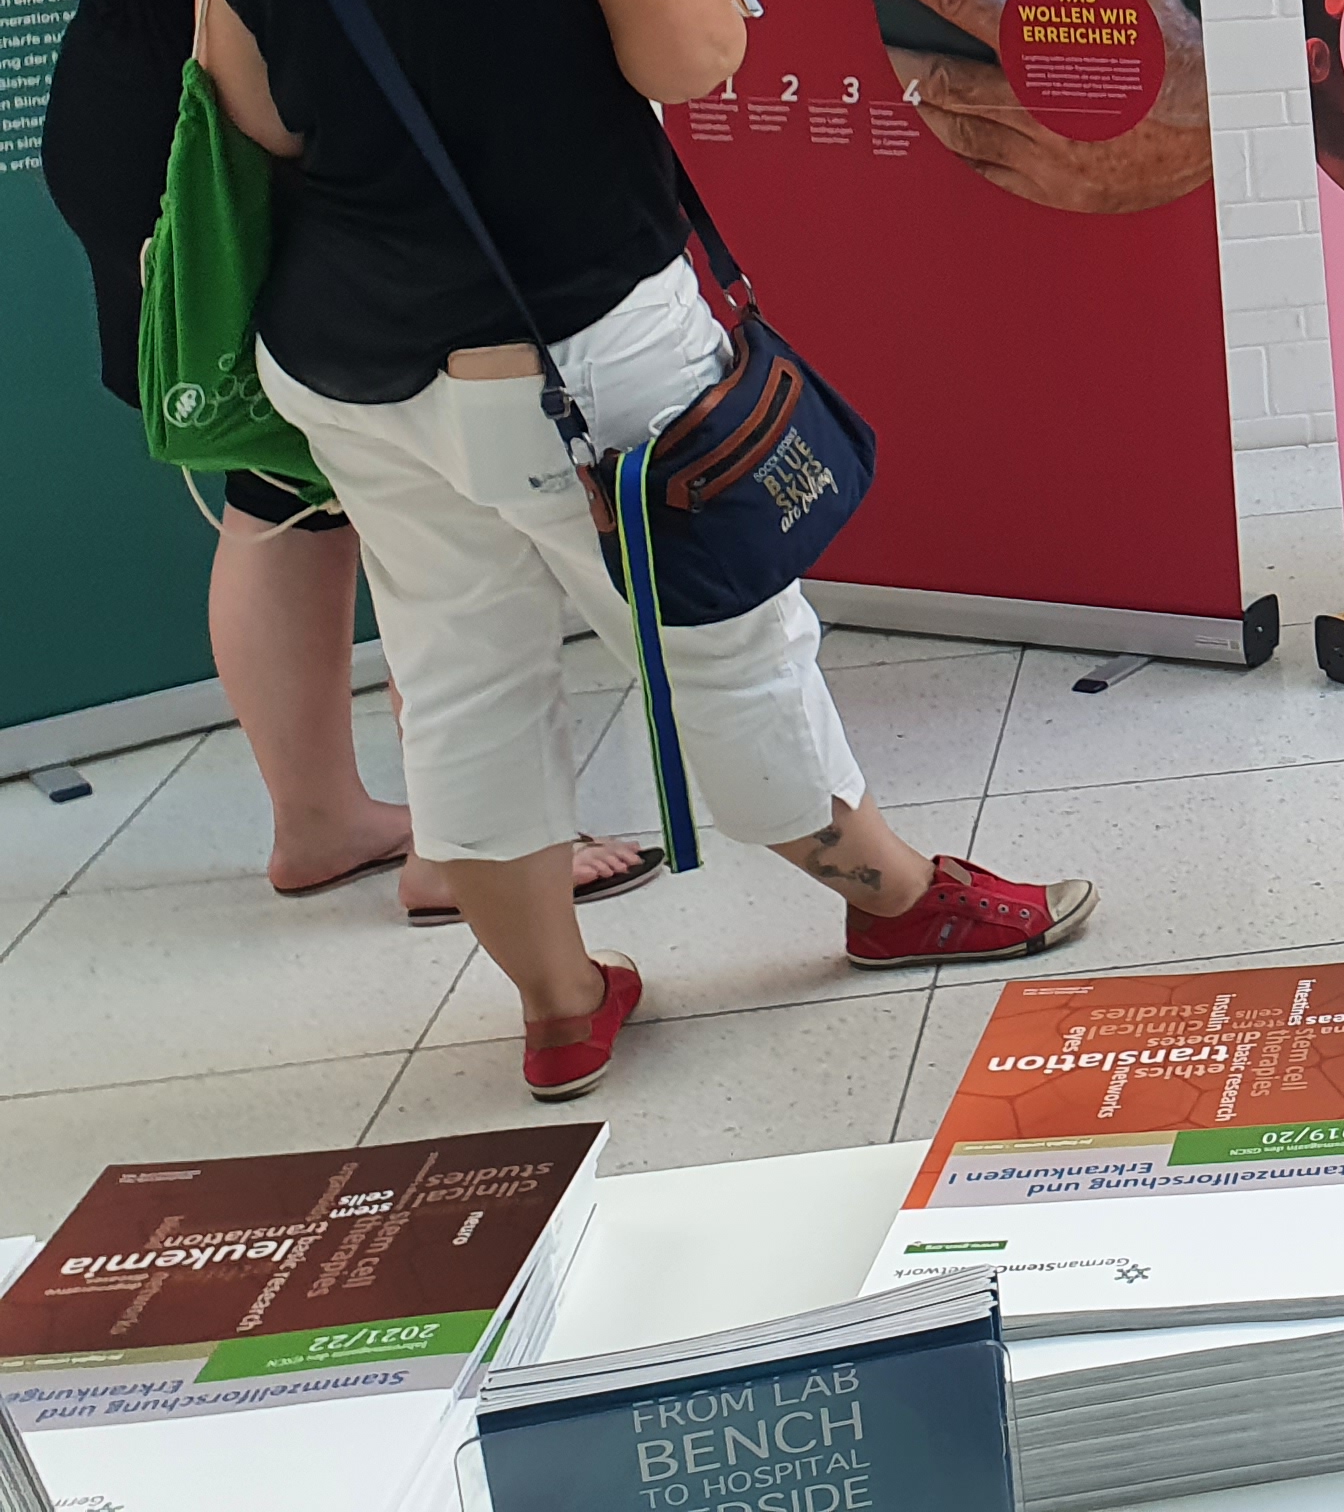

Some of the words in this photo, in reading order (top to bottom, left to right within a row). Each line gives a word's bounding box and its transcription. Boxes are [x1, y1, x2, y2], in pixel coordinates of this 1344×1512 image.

[1018, 4, 1096, 24] WOLLEN
[1099, 7, 1138, 25] WIR
[1022, 25, 1138, 45] ERREICHEN?
[721, 75, 738, 100] 1
[781, 74, 799, 102] 2
[842, 76, 860, 104] 3
[903, 78, 922, 106] 4
[763, 435, 812, 498] BLUE
[1090, 1003, 1209, 1025] studies
[1207, 992, 1236, 1033] insulin
[1062, 1026, 1086, 1053] eyes
[1089, 1018, 1204, 1041] clinical
[1146, 1029, 1262, 1050] diabetes
[988, 1044, 1230, 1074] translation
[1134, 1061, 1226, 1081] ethics
[1231, 1044, 1252, 1071] basic
[1250, 1029, 1291, 1097] therapies
[1097, 1065, 1128, 1119] networks
[1215, 1071, 1243, 1124] research
[959, 1161, 1154, 1185] Erkrankungen
[338, 1188, 395, 1206] cells
[1026, 1180, 1081, 1198] und
[329, 1201, 395, 1221] stem
[164, 1218, 328, 1251] translation
[59, 1237, 294, 1281] leukemia
[309, 1322, 441, 1352] 2021/22
[102, 1368, 411, 1419] Stammzellforschung
[632, 1381, 755, 1434] FROM
[772, 1361, 861, 1408] LAB
[36, 1402, 96, 1425] und
[636, 1399, 865, 1484] BENCH
[639, 1482, 690, 1510] TO
[702, 1448, 872, 1499] HOSPITAL
